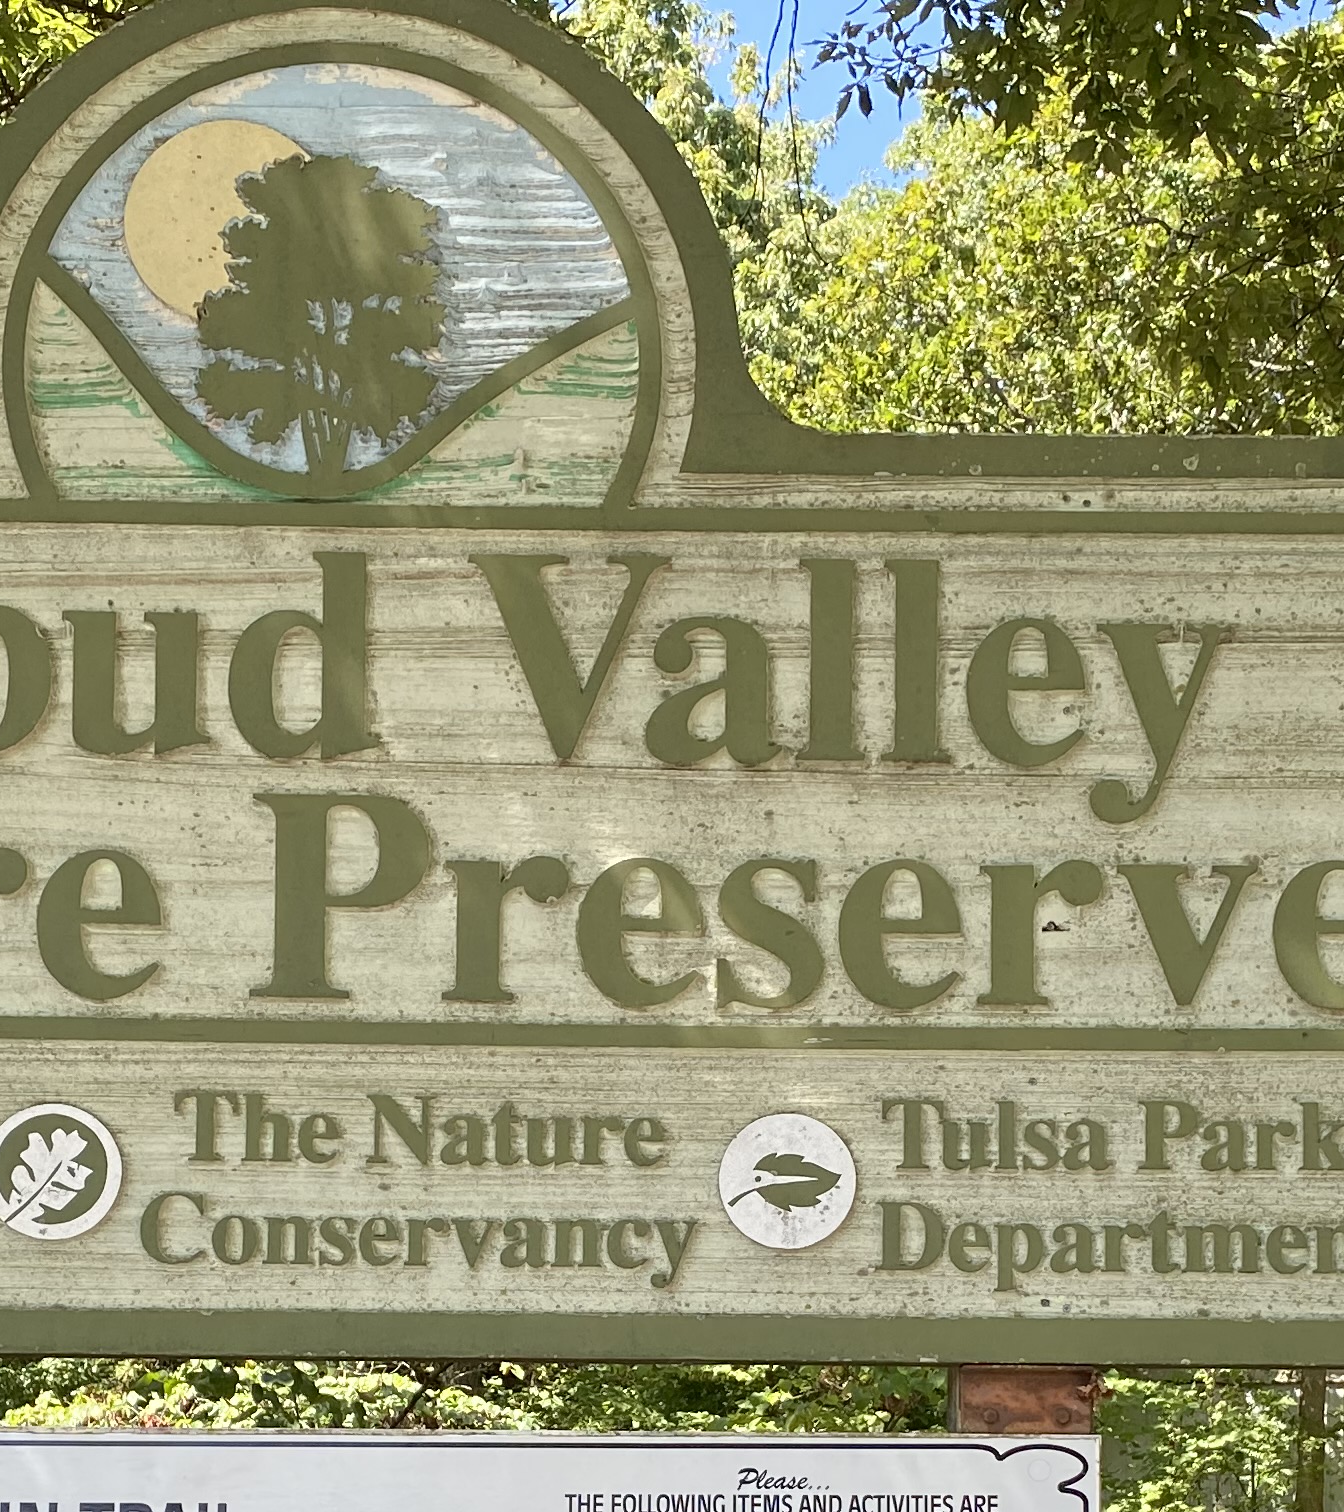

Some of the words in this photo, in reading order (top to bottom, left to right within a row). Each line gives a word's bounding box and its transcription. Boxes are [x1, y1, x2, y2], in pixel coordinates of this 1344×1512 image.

[468, 552, 1234, 824] Valley
[174, 1087, 340, 1166] The
[365, 1092, 667, 1171] Nature
[880, 1097, 1114, 1173] Tulsa
[139, 1191, 698, 1288] Conservancy
[736, 1467, 830, 1491] Please...
